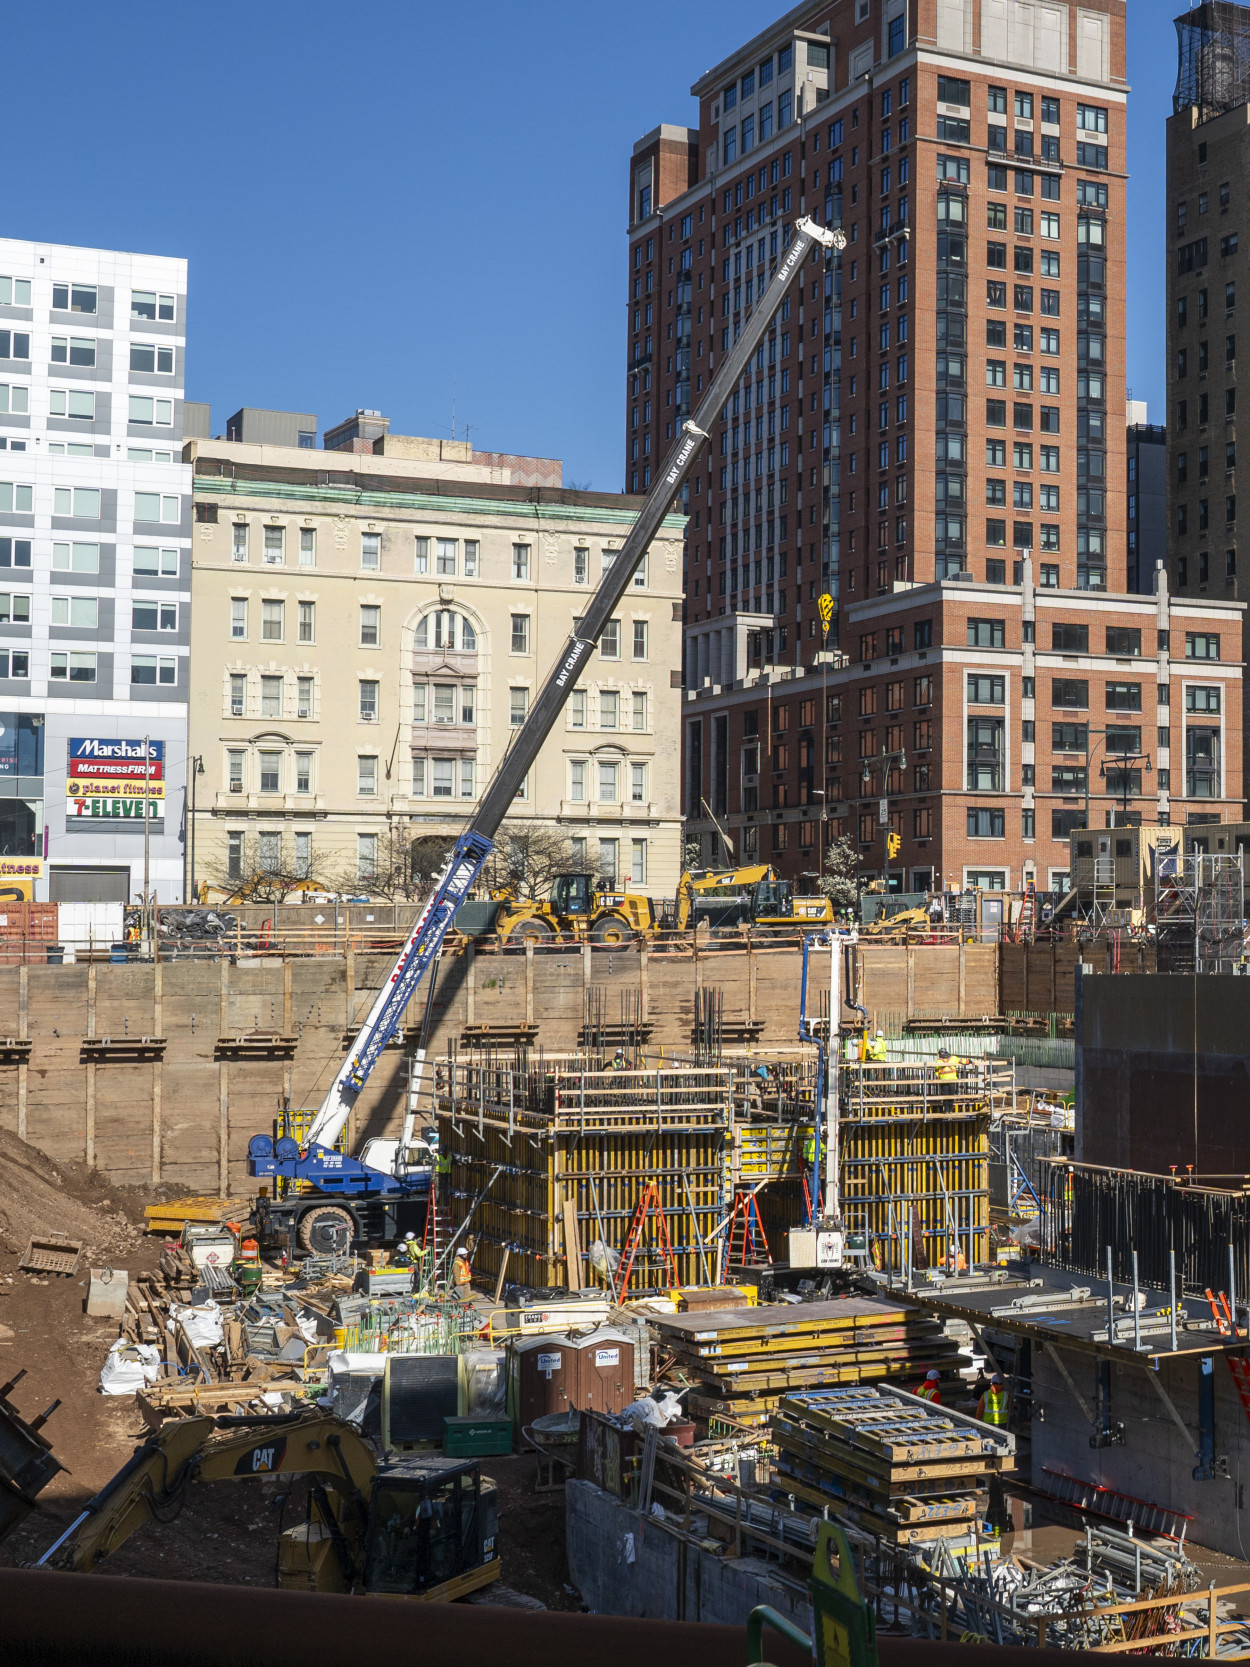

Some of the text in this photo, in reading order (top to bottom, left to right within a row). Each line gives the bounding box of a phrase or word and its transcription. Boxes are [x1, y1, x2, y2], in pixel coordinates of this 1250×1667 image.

[778, 240, 805, 281] BAY CRANE
[666, 439, 695, 484] BAY CRANE
[555, 642, 585, 687] BAY CRANE
[76, 740, 157, 758] Marshals
[82, 783, 121, 795] planet
[600, 896, 614, 906] CAT
[252, 1448, 275, 1471] CAT
[483, 1536, 495, 1553] CAT
